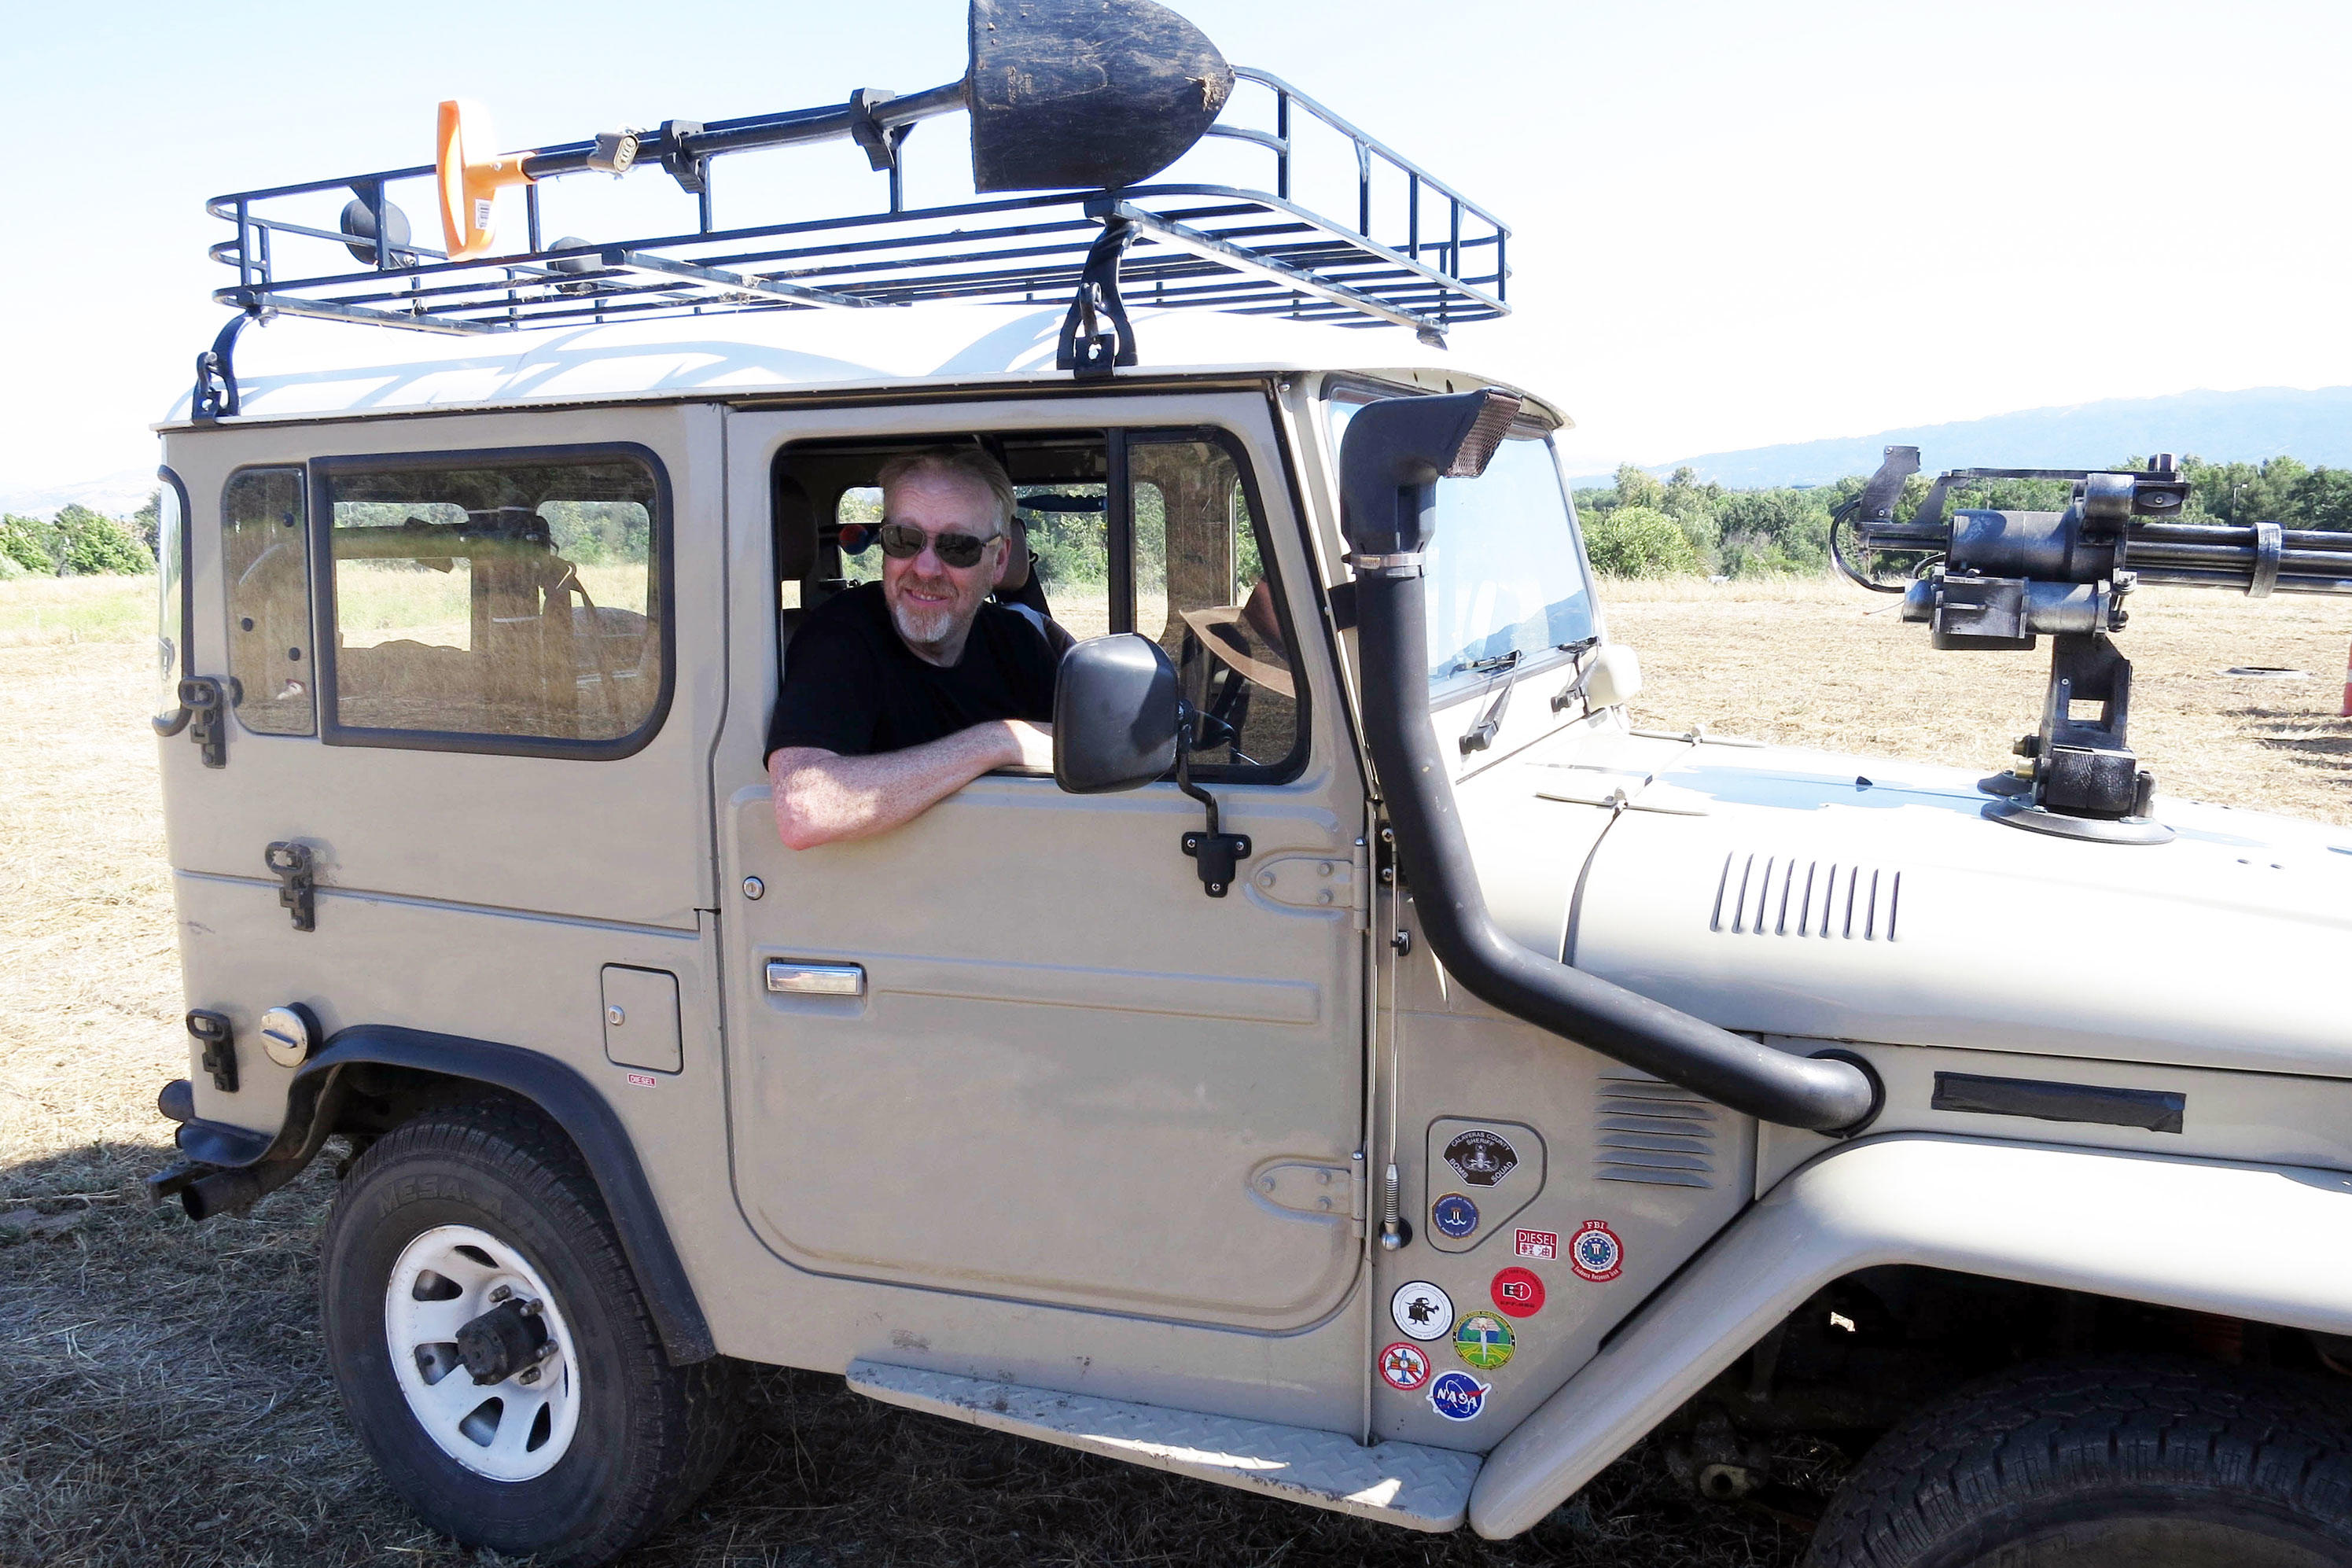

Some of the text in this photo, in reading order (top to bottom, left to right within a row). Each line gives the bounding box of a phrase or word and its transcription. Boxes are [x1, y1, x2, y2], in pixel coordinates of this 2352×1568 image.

[630, 1075, 654, 1085] DIESEL
[1451, 1132, 1510, 1150] CALAVERAS COUNTY
[1466, 1137, 1495, 1147] SHERIFF
[1448, 1158, 1513, 1182] BOMB SQUAD
[1518, 1231, 1555, 1246] DIESEL
[1437, 1387, 1478, 1408] NASA
